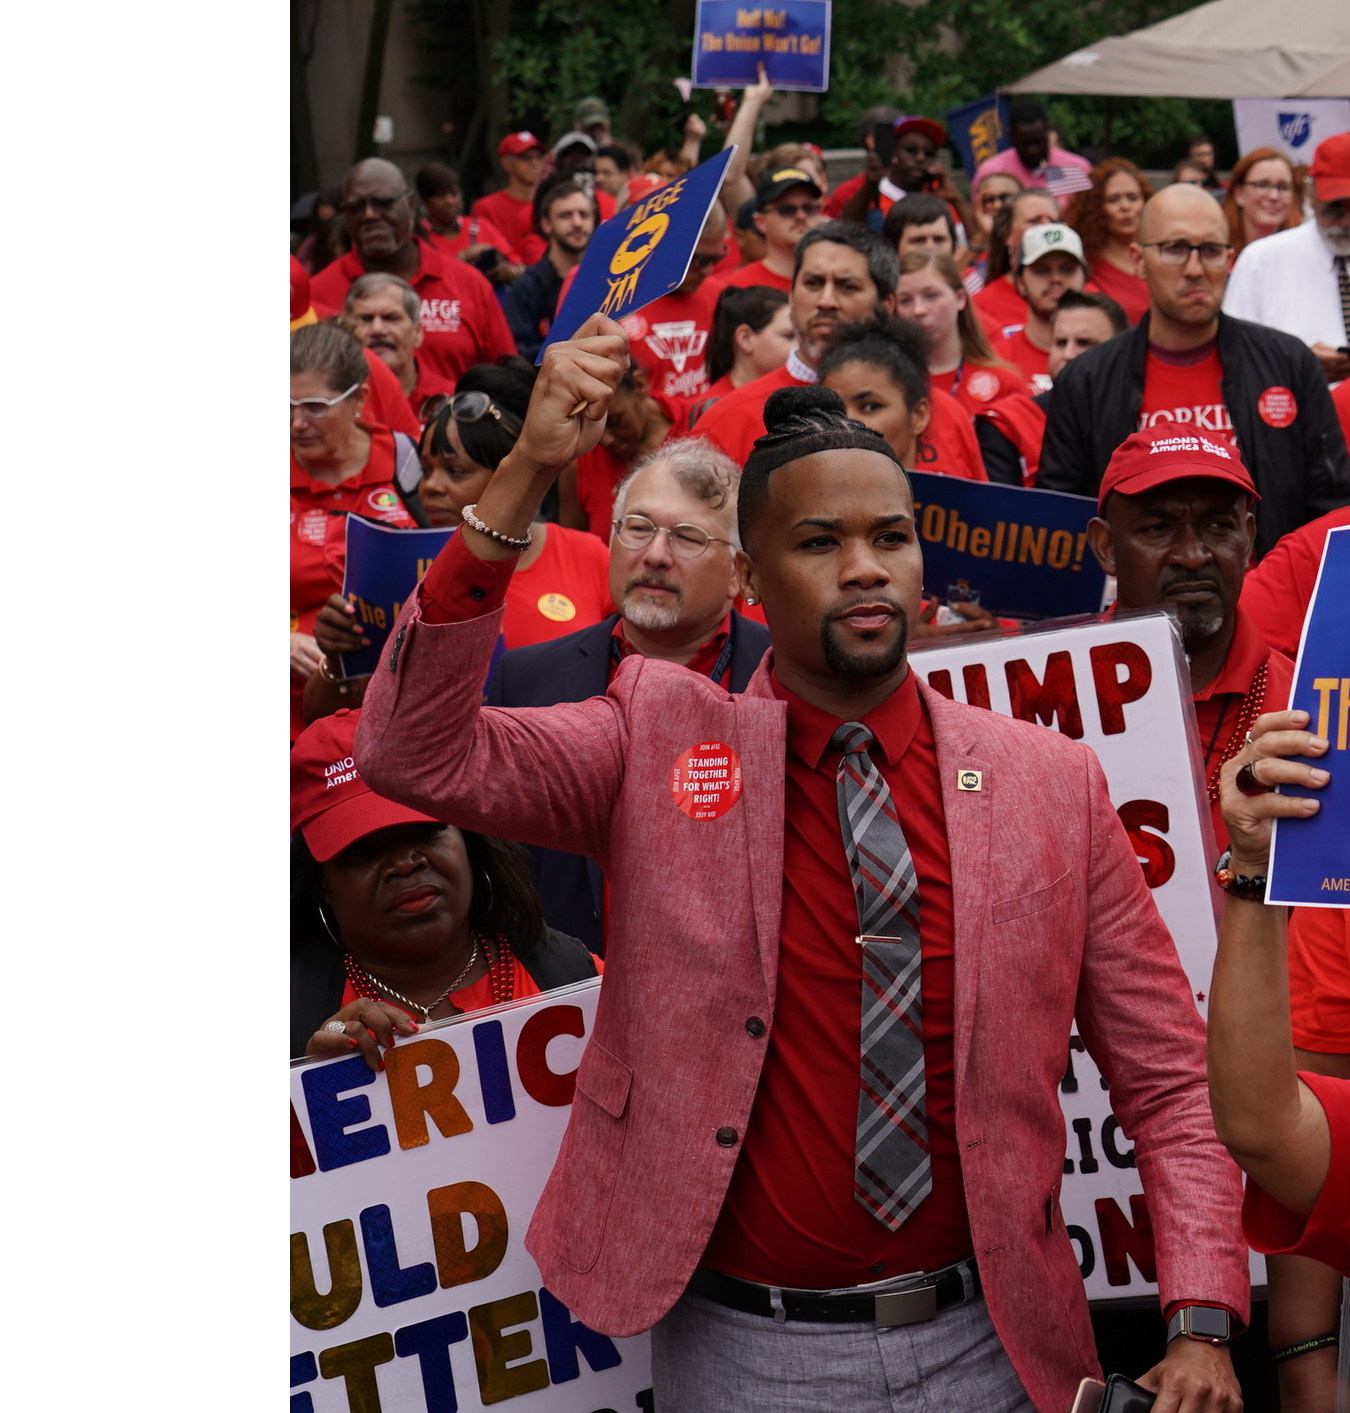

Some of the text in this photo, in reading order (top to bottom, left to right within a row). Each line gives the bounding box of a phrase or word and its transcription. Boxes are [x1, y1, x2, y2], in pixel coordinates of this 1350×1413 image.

[625, 178, 689, 230] AFGE
[420, 298, 461, 320] AFGE
[1149, 443, 1200, 455] America
[912, 502, 1088, 573] OhellNO!
[688, 757, 728, 768] STANDING
[326, 769, 360, 790] Amer
[688, 769, 728, 780] TOGETHER
[683, 781, 730, 792] FOR WHAT'S
[693, 793, 720, 803] RIGHT!
[290, 1004, 586, 1179] ERIC
